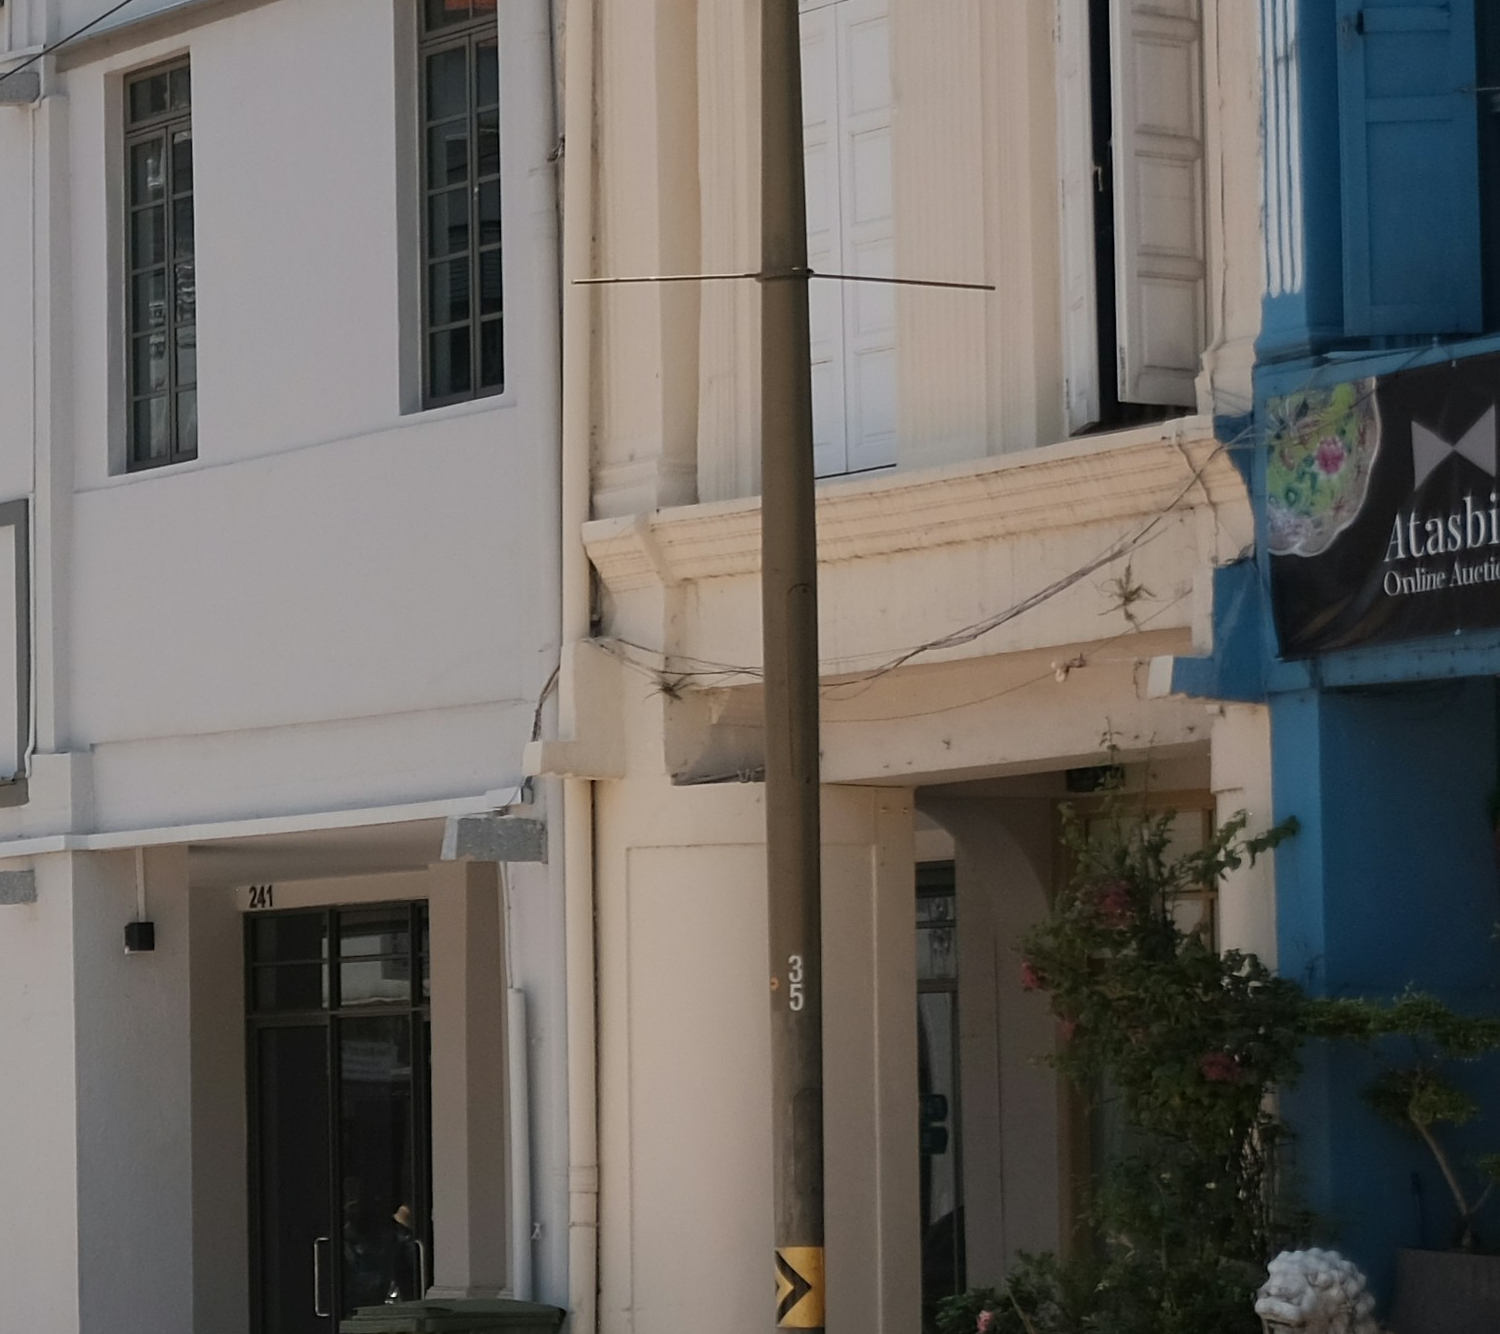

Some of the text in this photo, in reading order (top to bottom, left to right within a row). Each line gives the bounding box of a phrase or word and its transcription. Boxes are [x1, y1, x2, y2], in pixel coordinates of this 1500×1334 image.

[1383, 566, 1447, 597] Online
[249, 884, 273, 909] 241
[788, 954, 804, 1012] 35
